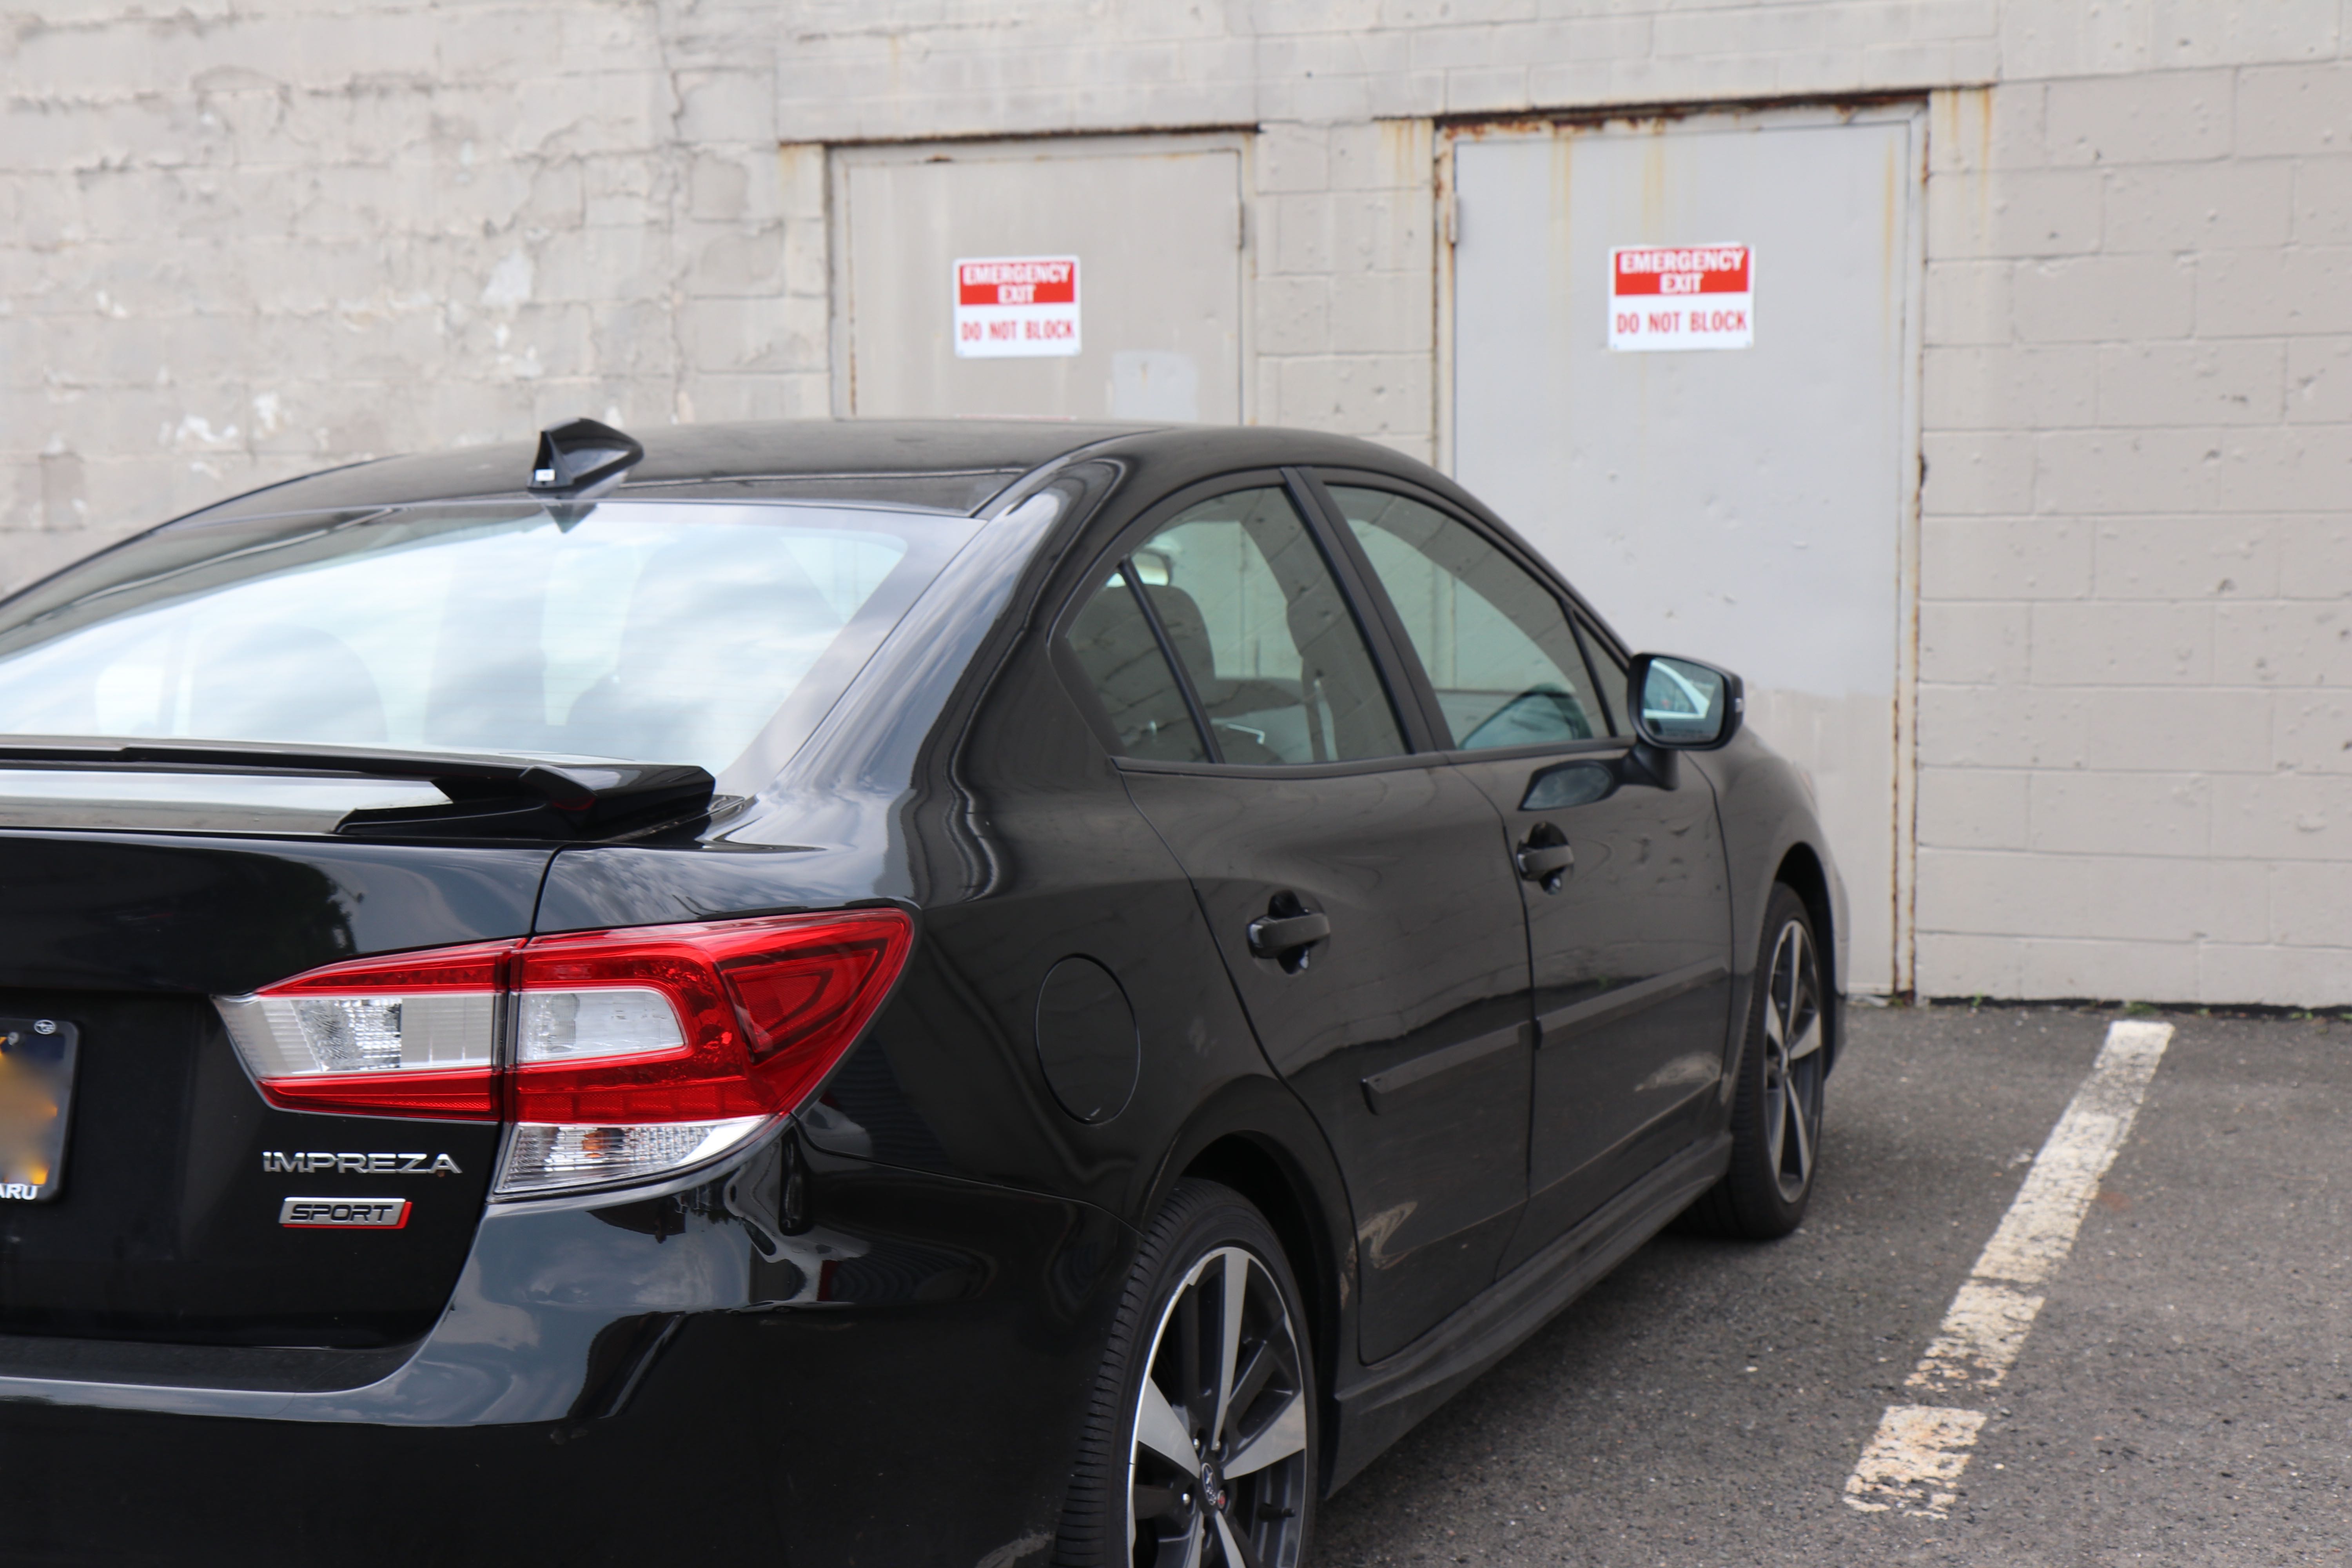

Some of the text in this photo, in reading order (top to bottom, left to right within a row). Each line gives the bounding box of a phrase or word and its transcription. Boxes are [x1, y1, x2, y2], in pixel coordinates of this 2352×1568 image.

[1620, 250, 1744, 273] EMERGENCY
[963, 264, 1072, 285] EMERGENCY
[1661, 273, 1704, 293] EXIT
[998, 284, 1036, 303] EXIT
[962, 320, 1074, 341] DO NOT BLOCK
[1617, 310, 1747, 334] DO NOT BLOCK
[263, 1152, 462, 1173] IMPREZA
[289, 1204, 392, 1222] SPORT
